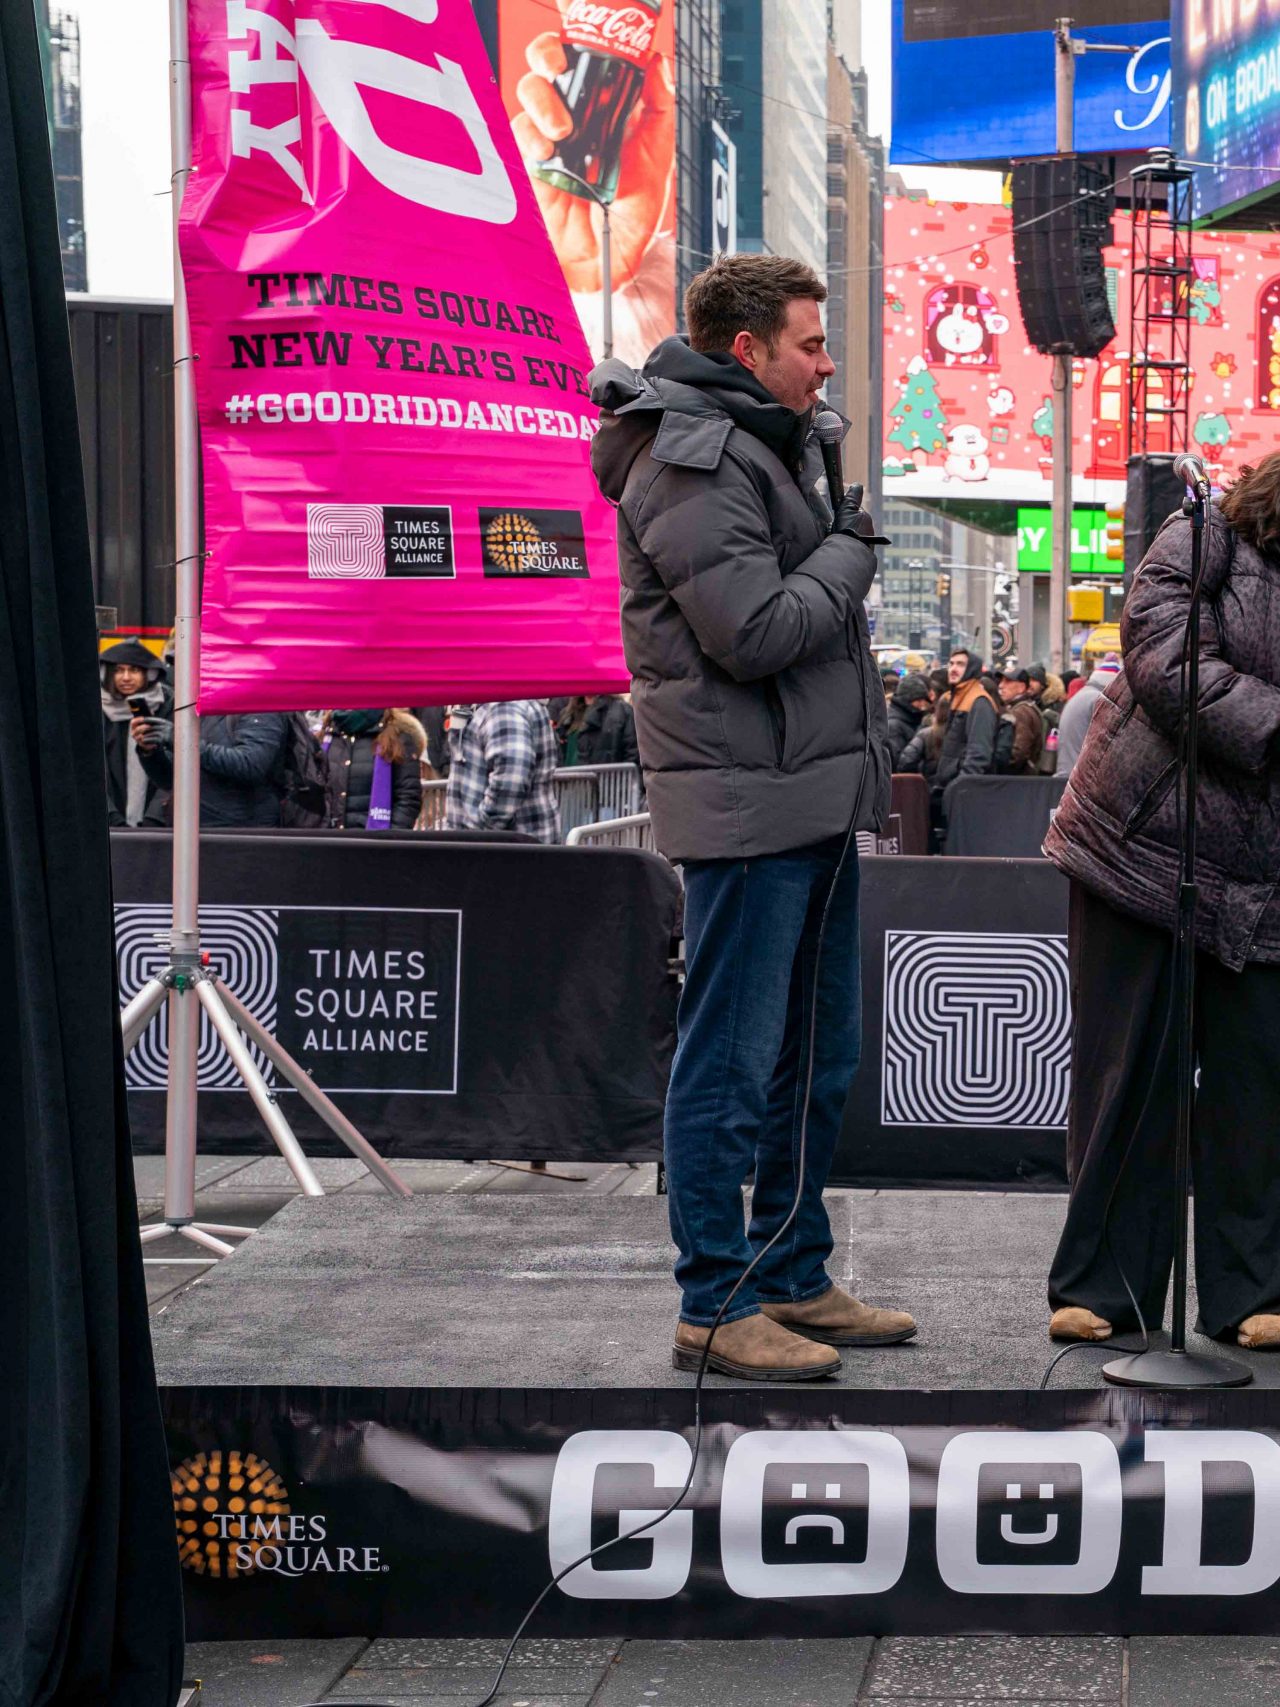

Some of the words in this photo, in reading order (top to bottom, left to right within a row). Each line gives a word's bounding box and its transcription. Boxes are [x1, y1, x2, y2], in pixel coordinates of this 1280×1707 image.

[1206, 75, 1228, 129] ON
[247, 271, 401, 315] TIMES
[413, 286, 562, 345] SQUARE
[229, 331, 353, 369] NEW
[365, 334, 515, 383] YEAR'S
[394, 520, 440, 535] TIMES
[390, 537, 446, 552] SQUARE
[394, 552, 443, 564] ALLIANCE
[509, 541, 558, 555] TIMES
[308, 949, 426, 980] TIMES
[294, 988, 439, 1023] SQUARE
[303, 1028, 429, 1052] ALLIANCE
[212, 1513, 327, 1542] TIMES
